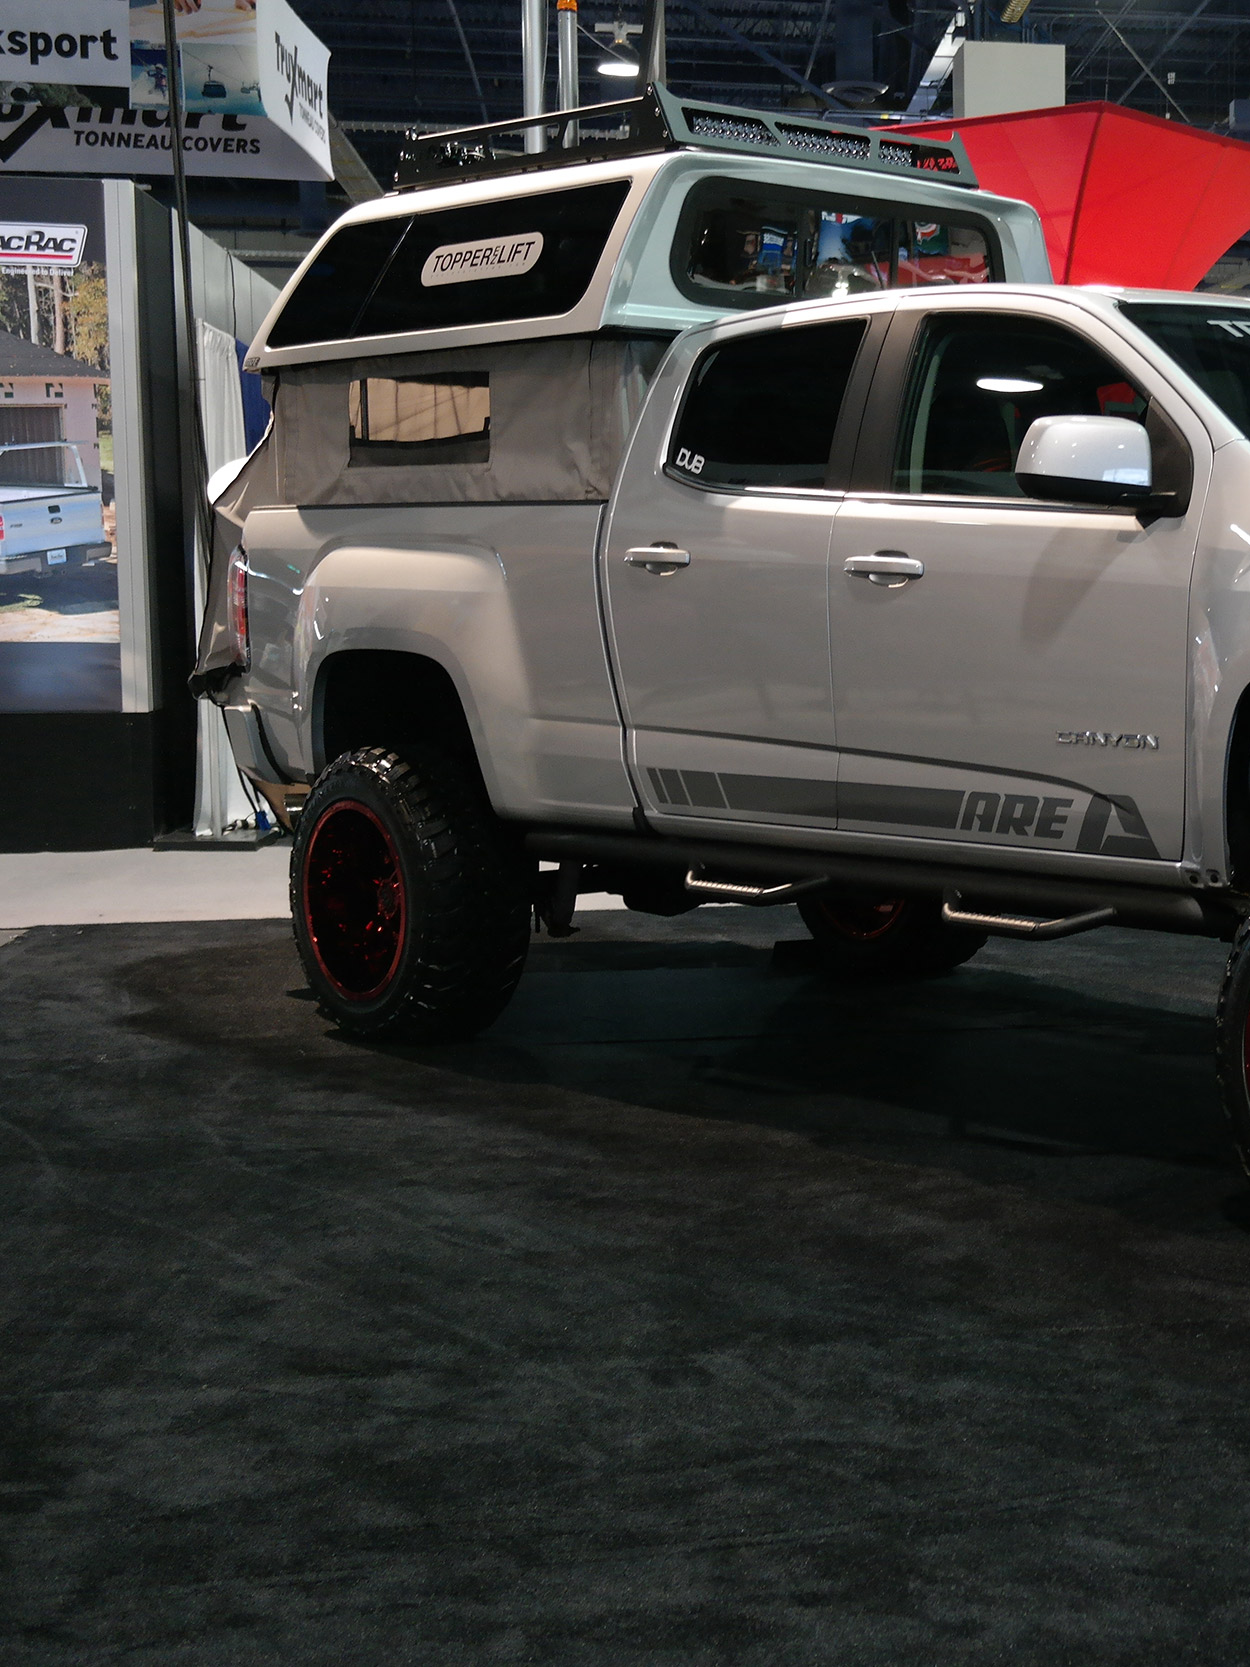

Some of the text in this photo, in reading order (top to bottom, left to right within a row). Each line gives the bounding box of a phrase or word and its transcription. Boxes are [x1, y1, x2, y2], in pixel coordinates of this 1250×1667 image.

[74, 130, 260, 154] TONNEAU COVERS
[675, 447, 705, 475] DUB
[1056, 731, 1159, 750] CANYON
[961, 791, 1076, 840] ARE
